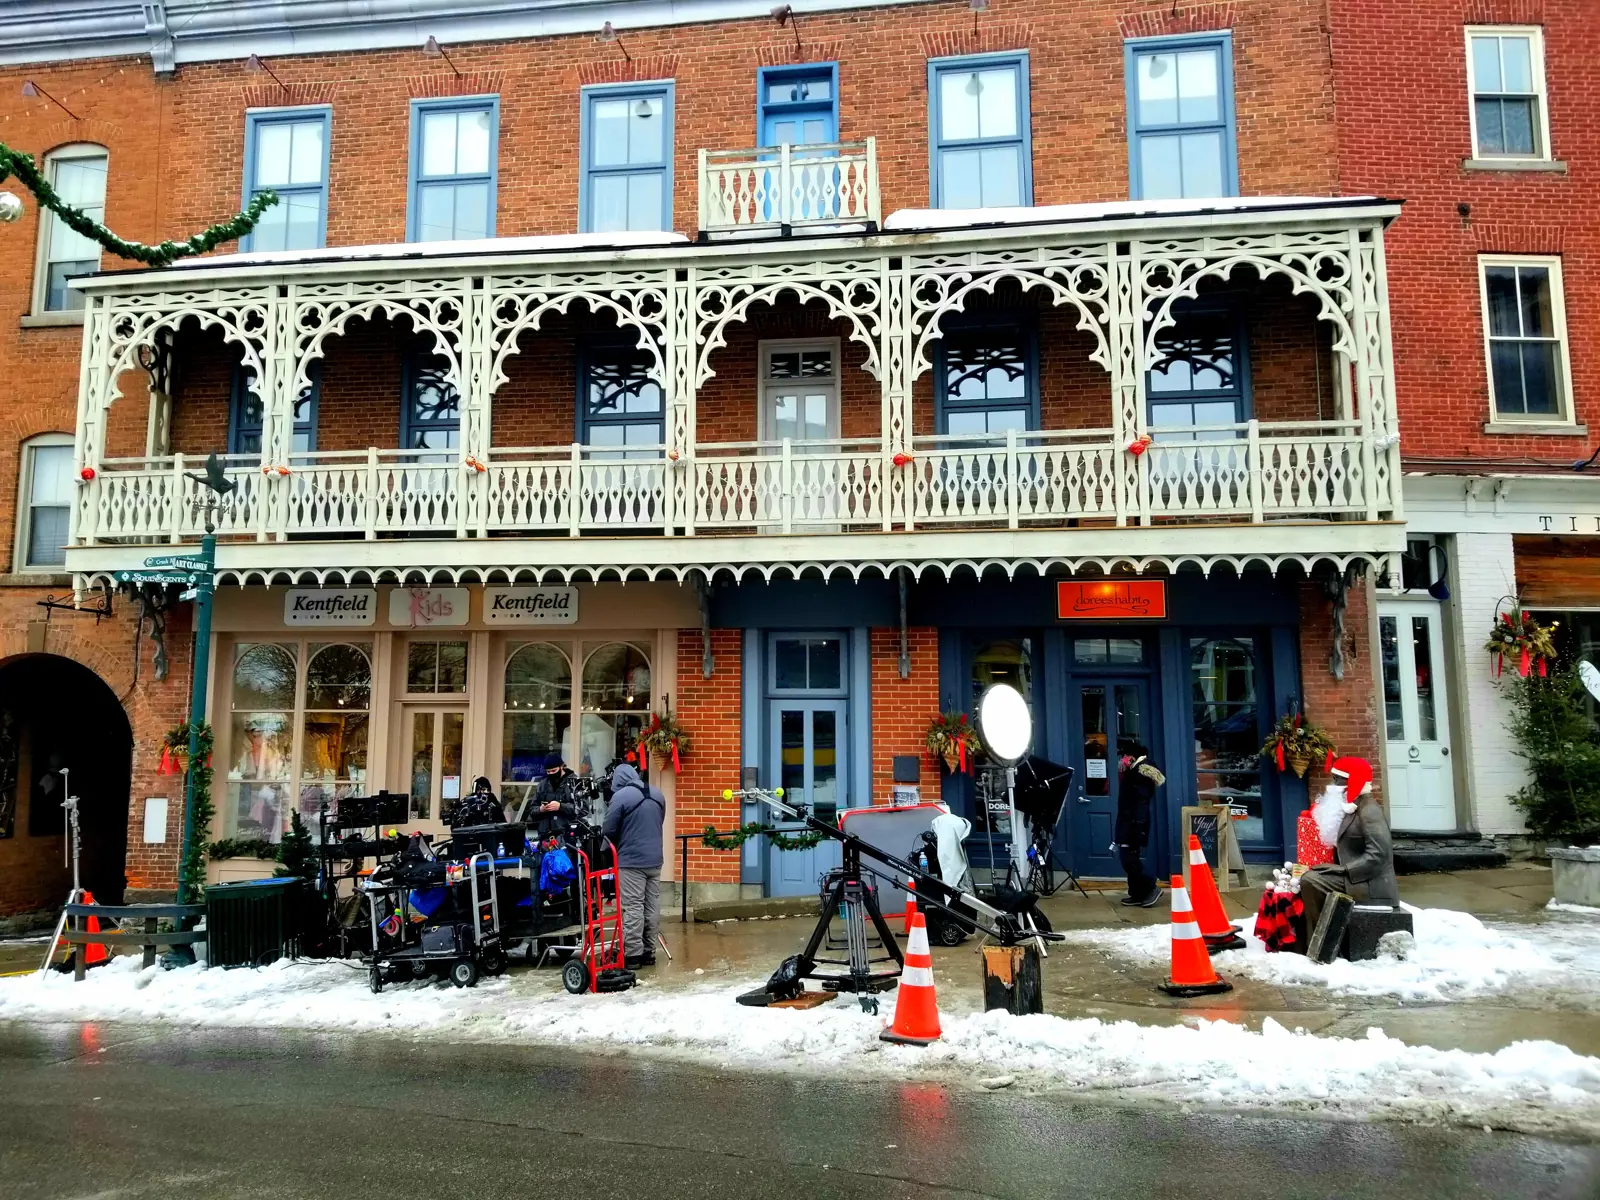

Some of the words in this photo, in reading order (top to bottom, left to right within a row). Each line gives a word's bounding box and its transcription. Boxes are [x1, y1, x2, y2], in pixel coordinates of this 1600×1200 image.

[187, 560, 207, 571] CLASSES
[492, 593, 569, 612] Kentfield
[1074, 584, 1113, 605] dorees
[293, 595, 368, 614] Kentfield
[1193, 816, 1217, 836] Yay!
